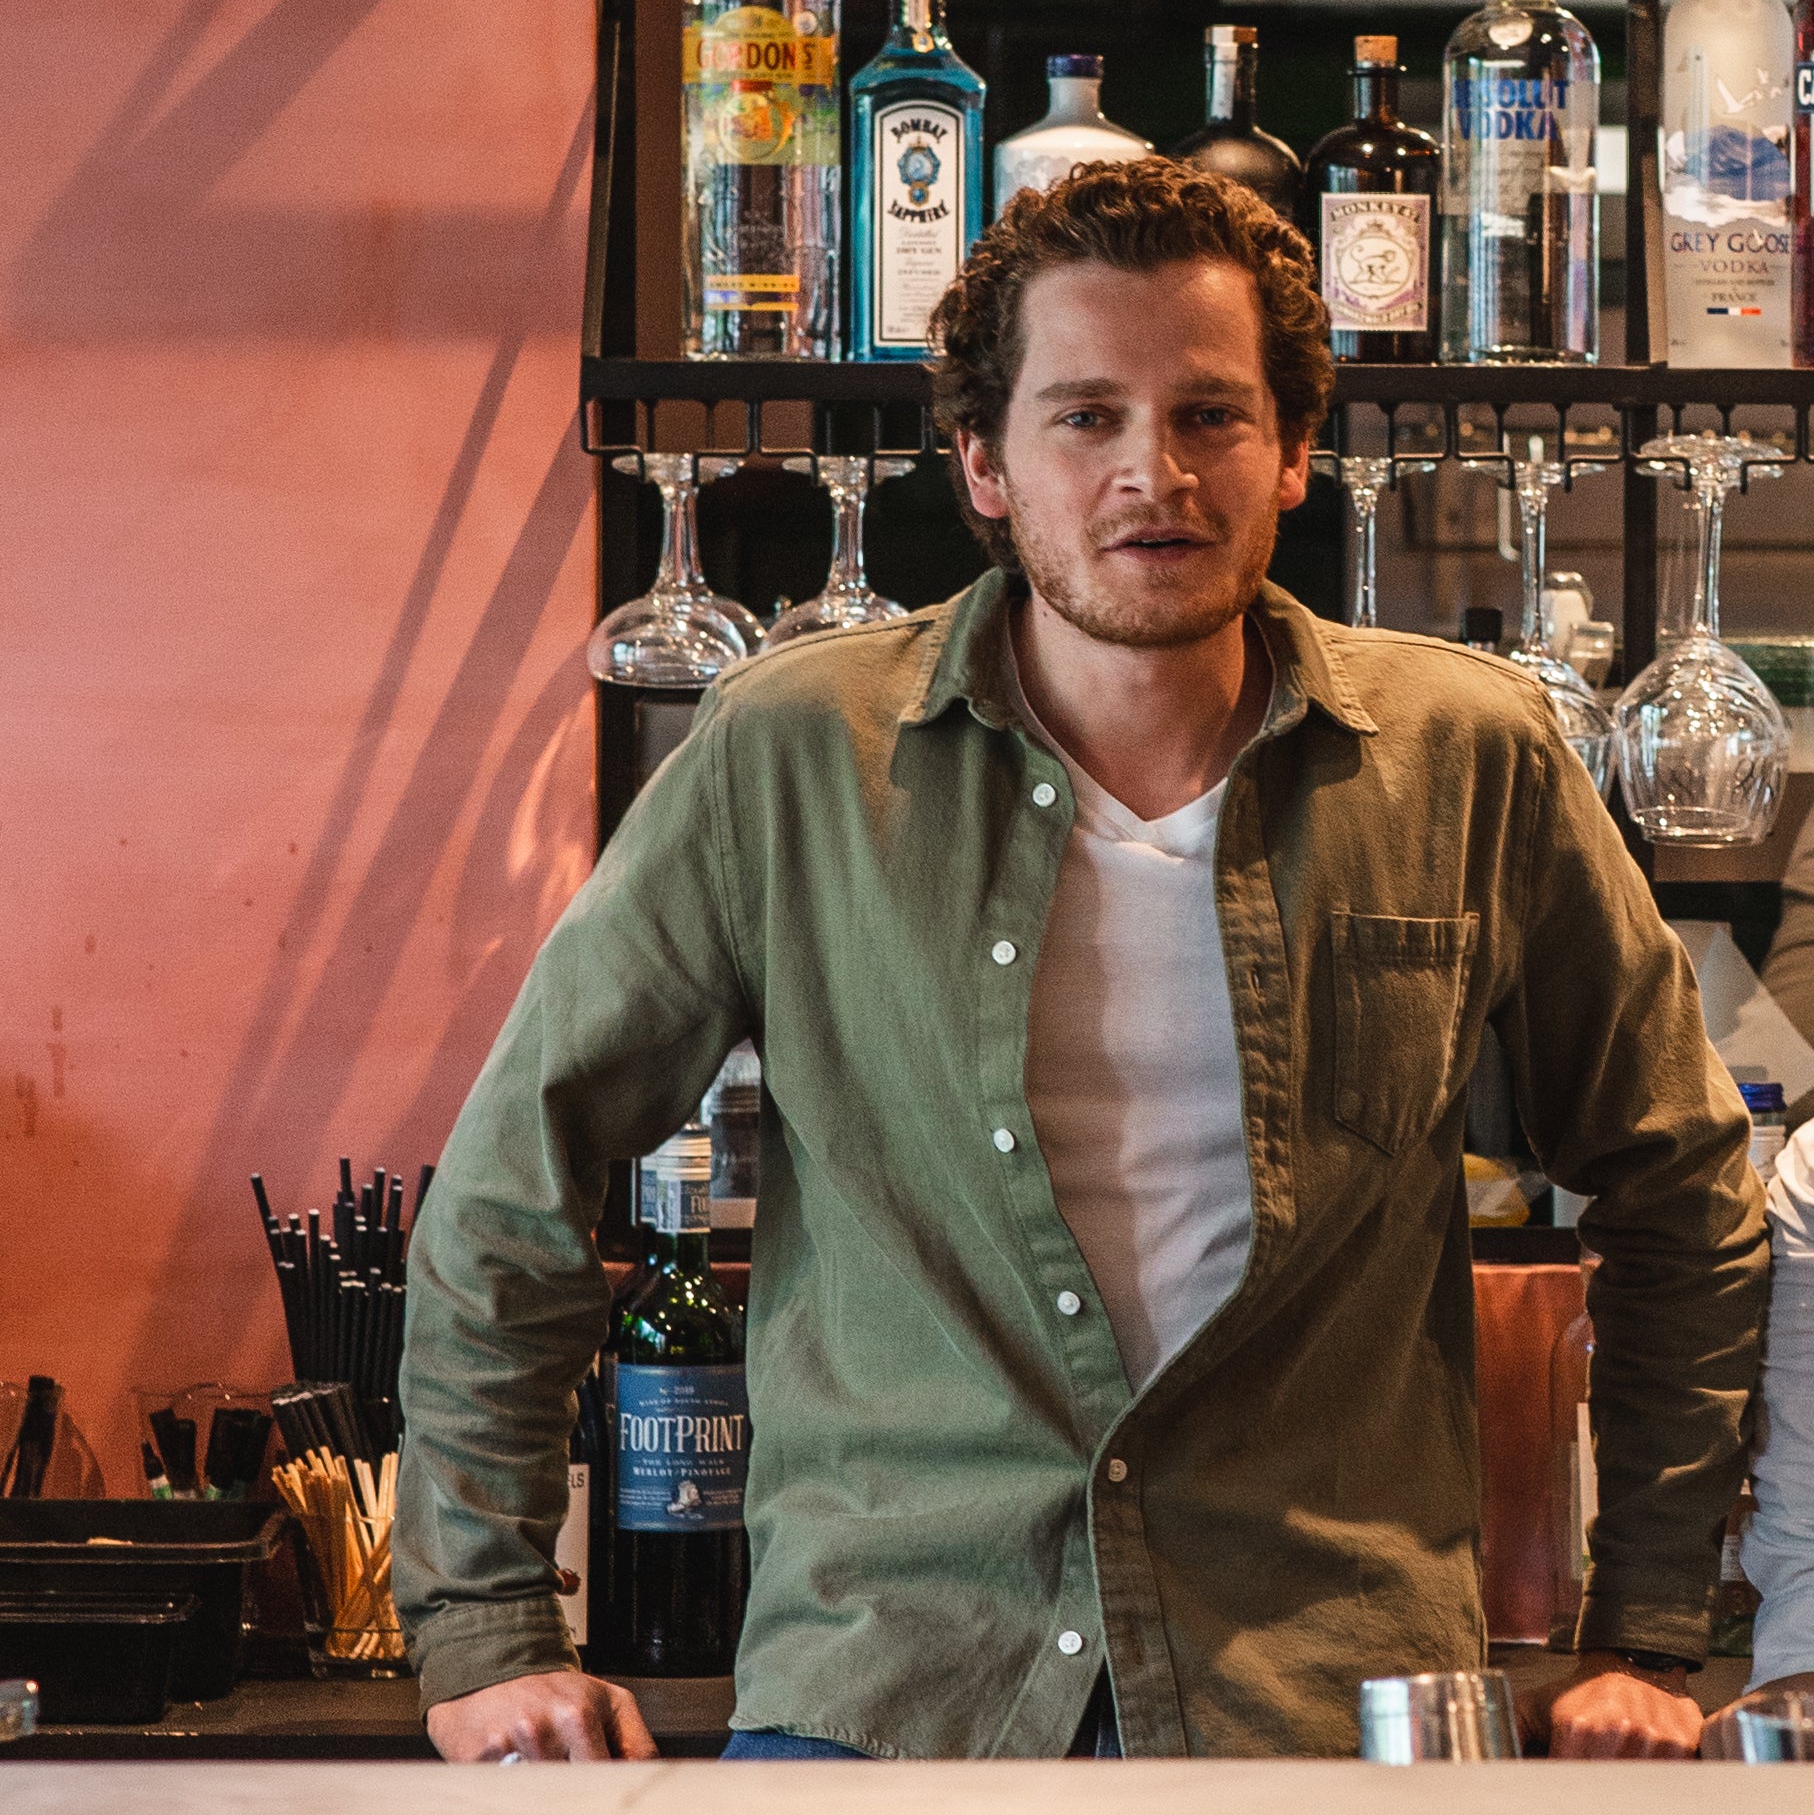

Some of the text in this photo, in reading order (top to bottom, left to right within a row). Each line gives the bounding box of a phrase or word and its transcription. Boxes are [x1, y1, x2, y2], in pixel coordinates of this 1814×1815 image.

[697, 39, 815, 70] GORDONS
[890, 118, 948, 144] BOMBAY
[1457, 110, 1559, 140] VODKA
[887, 199, 950, 224] SAPPHIRE
[1671, 232, 1790, 254] GREY GOOSE
[619, 1412, 744, 1454] FOOTPRINT
